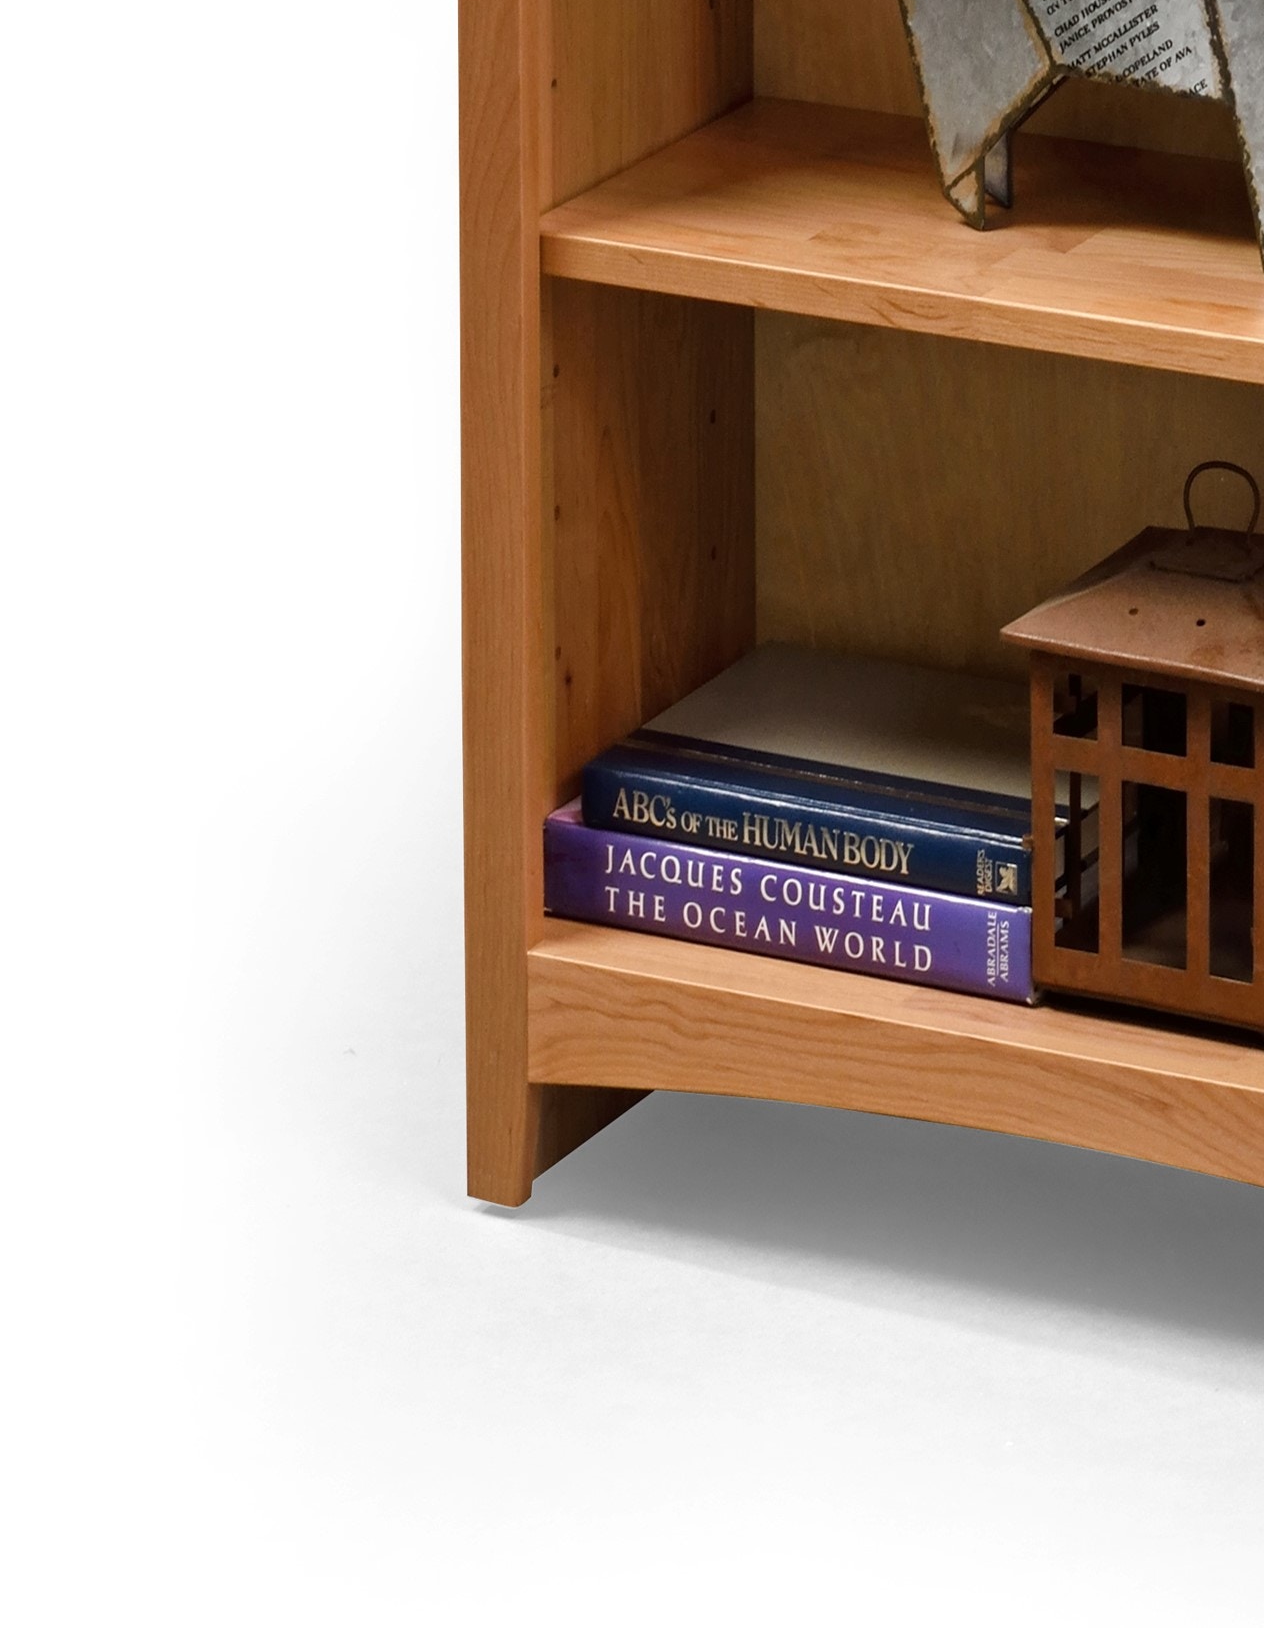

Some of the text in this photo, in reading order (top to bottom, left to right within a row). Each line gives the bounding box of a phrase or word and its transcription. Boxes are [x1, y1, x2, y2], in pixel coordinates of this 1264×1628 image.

[1054, 15, 1081, 38] CHAD
[1059, 23, 1092, 55] JANICE
[1085, 20, 1162, 78] STEPHAN PYLES
[1094, 4, 1160, 56] MCCALLISTER
[1158, 55, 1174, 73] OF
[1172, 45, 1193, 66] AVA
[613, 787, 914, 875] ABC's OF THE HUMAN BODY
[605, 844, 931, 931] JACQUES COUSTEAU
[605, 886, 932, 972] THE OCEAN WORLD
[987, 911, 997, 987] ABRADALE
[1000, 920, 1010, 983] ABRAMS
